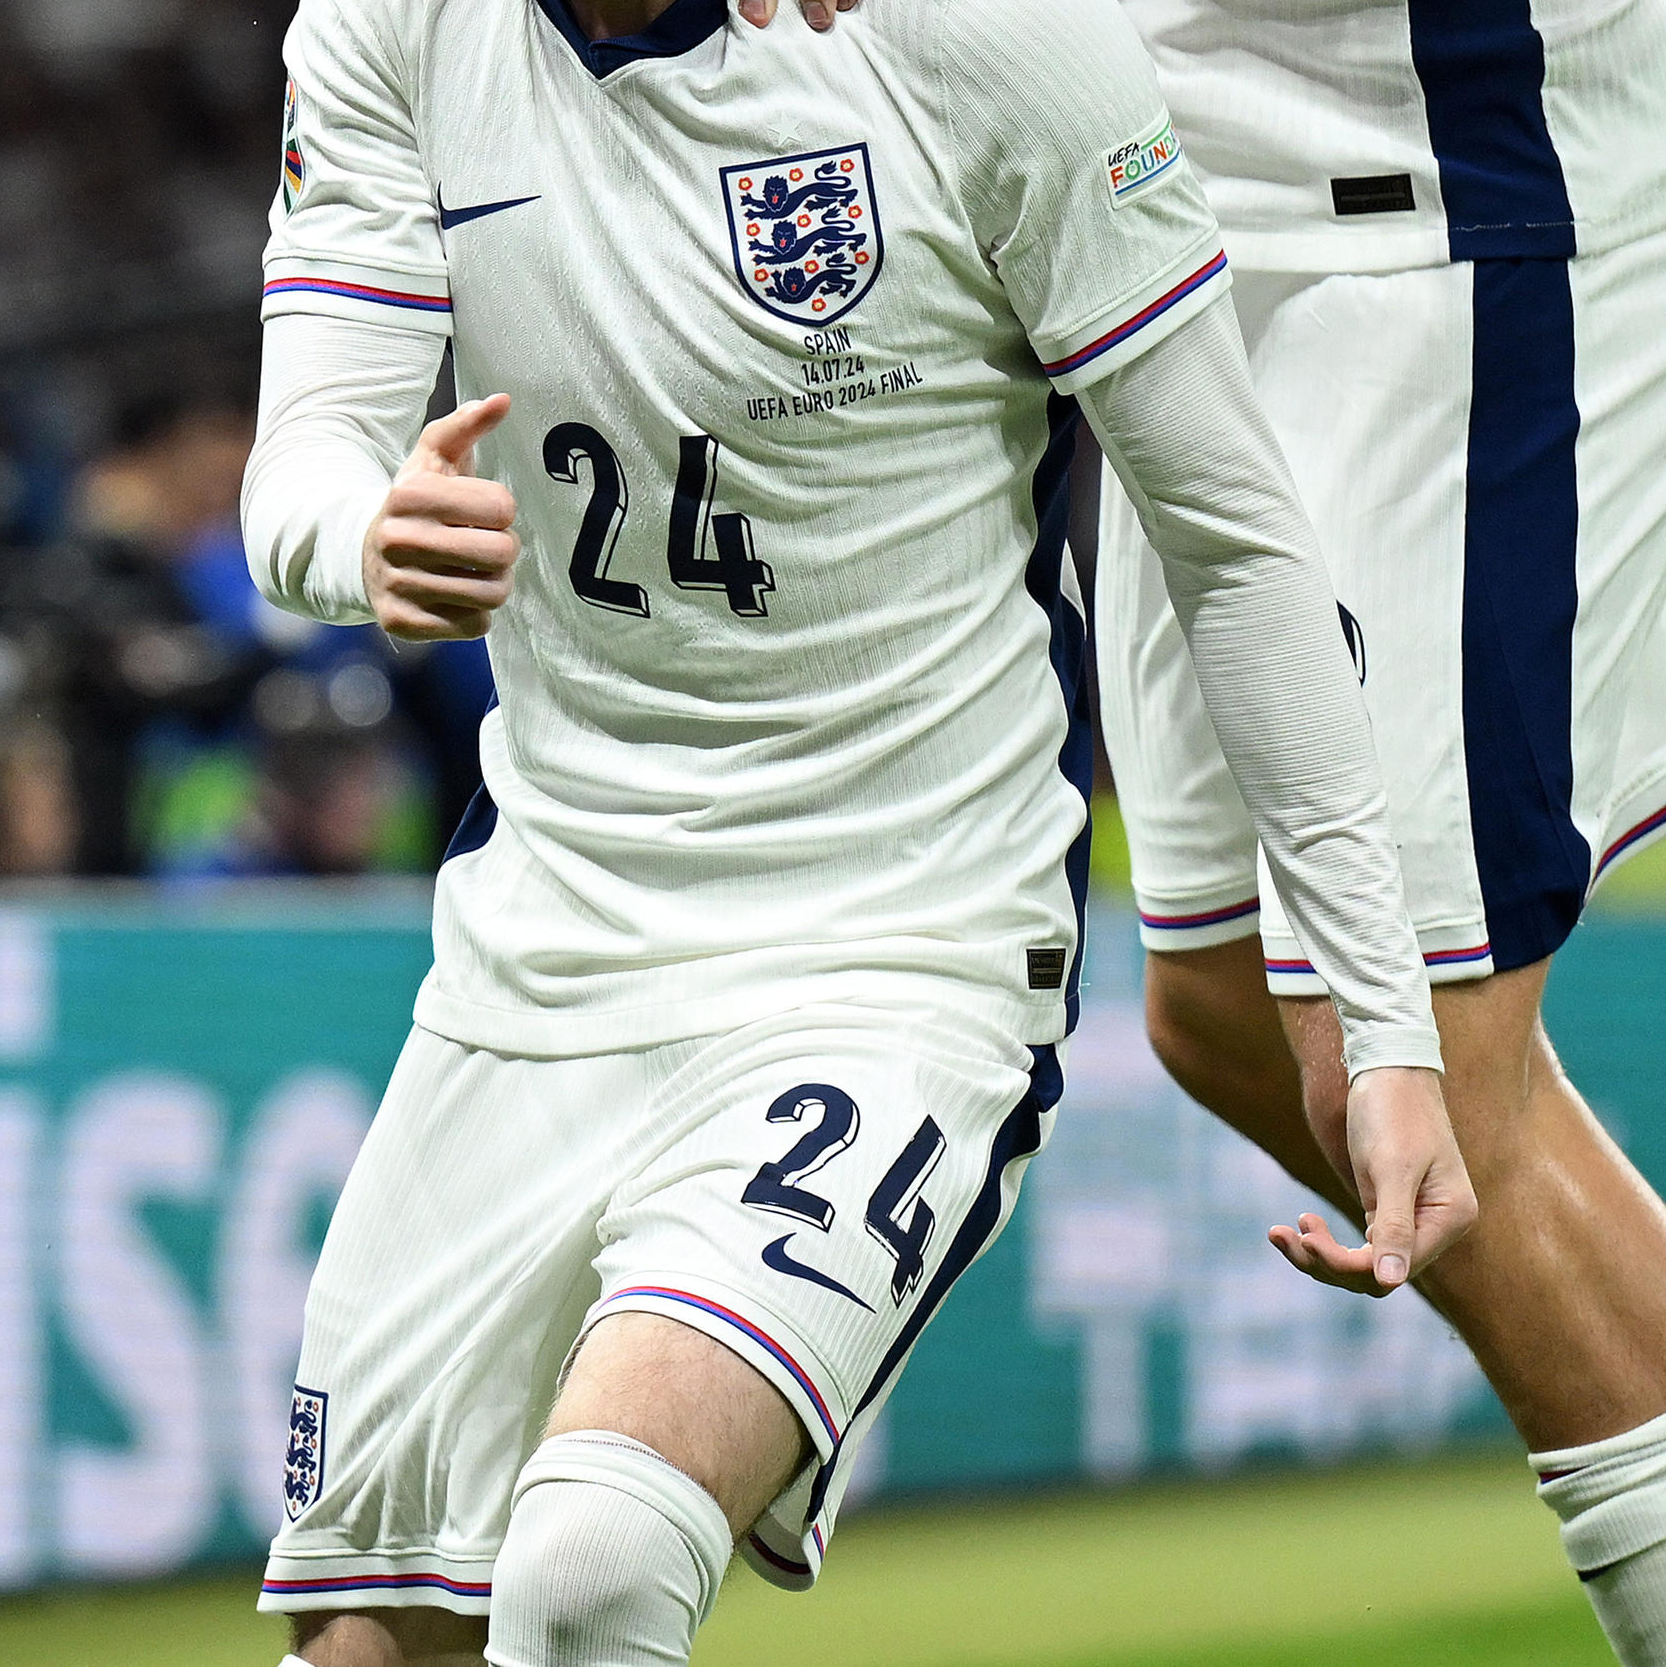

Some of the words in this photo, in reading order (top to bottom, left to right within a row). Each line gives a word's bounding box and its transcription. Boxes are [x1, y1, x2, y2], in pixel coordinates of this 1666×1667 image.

[1108, 142, 1140, 167] UEFA
[1110, 132, 1176, 189] FOUND
[804, 326, 852, 356] SPAIN
[746, 396, 789, 421] UEFA
[792, 390, 834, 417] EURO
[838, 379, 877, 407] 2024
[879, 361, 924, 395] FINAL
[801, 355, 865, 386] 14.07.24
[542, 421, 777, 619] 24
[740, 1082, 948, 1310] 24
